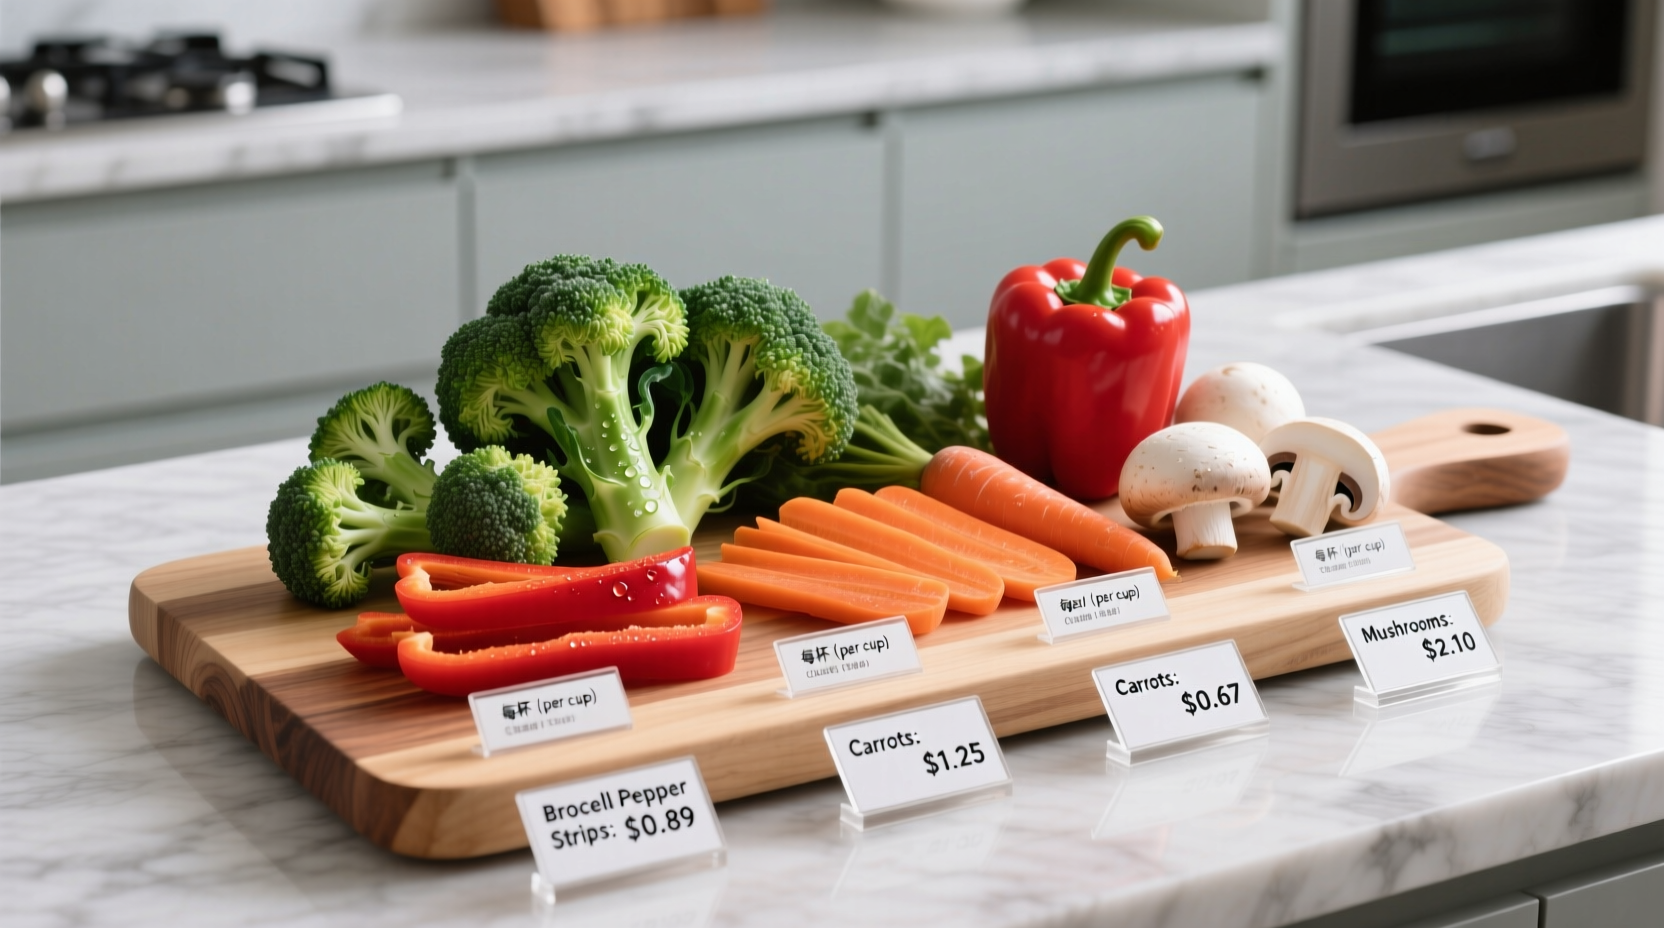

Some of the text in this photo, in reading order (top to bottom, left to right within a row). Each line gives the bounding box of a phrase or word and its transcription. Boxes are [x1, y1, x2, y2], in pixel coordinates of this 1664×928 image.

[1091, 592, 1113, 607] (per
[1116, 585, 1140, 601] cup)
[1361, 614, 1454, 643] Mushrooms:
[834, 643, 859, 661] (per
[863, 634, 889, 653] cup)
[1422, 631, 1476, 662] $2.10
[1115, 672, 1180, 696] Carrots:
[537, 698, 564, 714] (per
[567, 687, 597, 708] cup)
[1181, 682, 1239, 716] $0.67
[849, 731, 921, 757] Carrots:
[923, 742, 985, 776] $1.25
[542, 781, 687, 823] Brocell Pepper
[551, 806, 695, 850] Strips: $0.89
